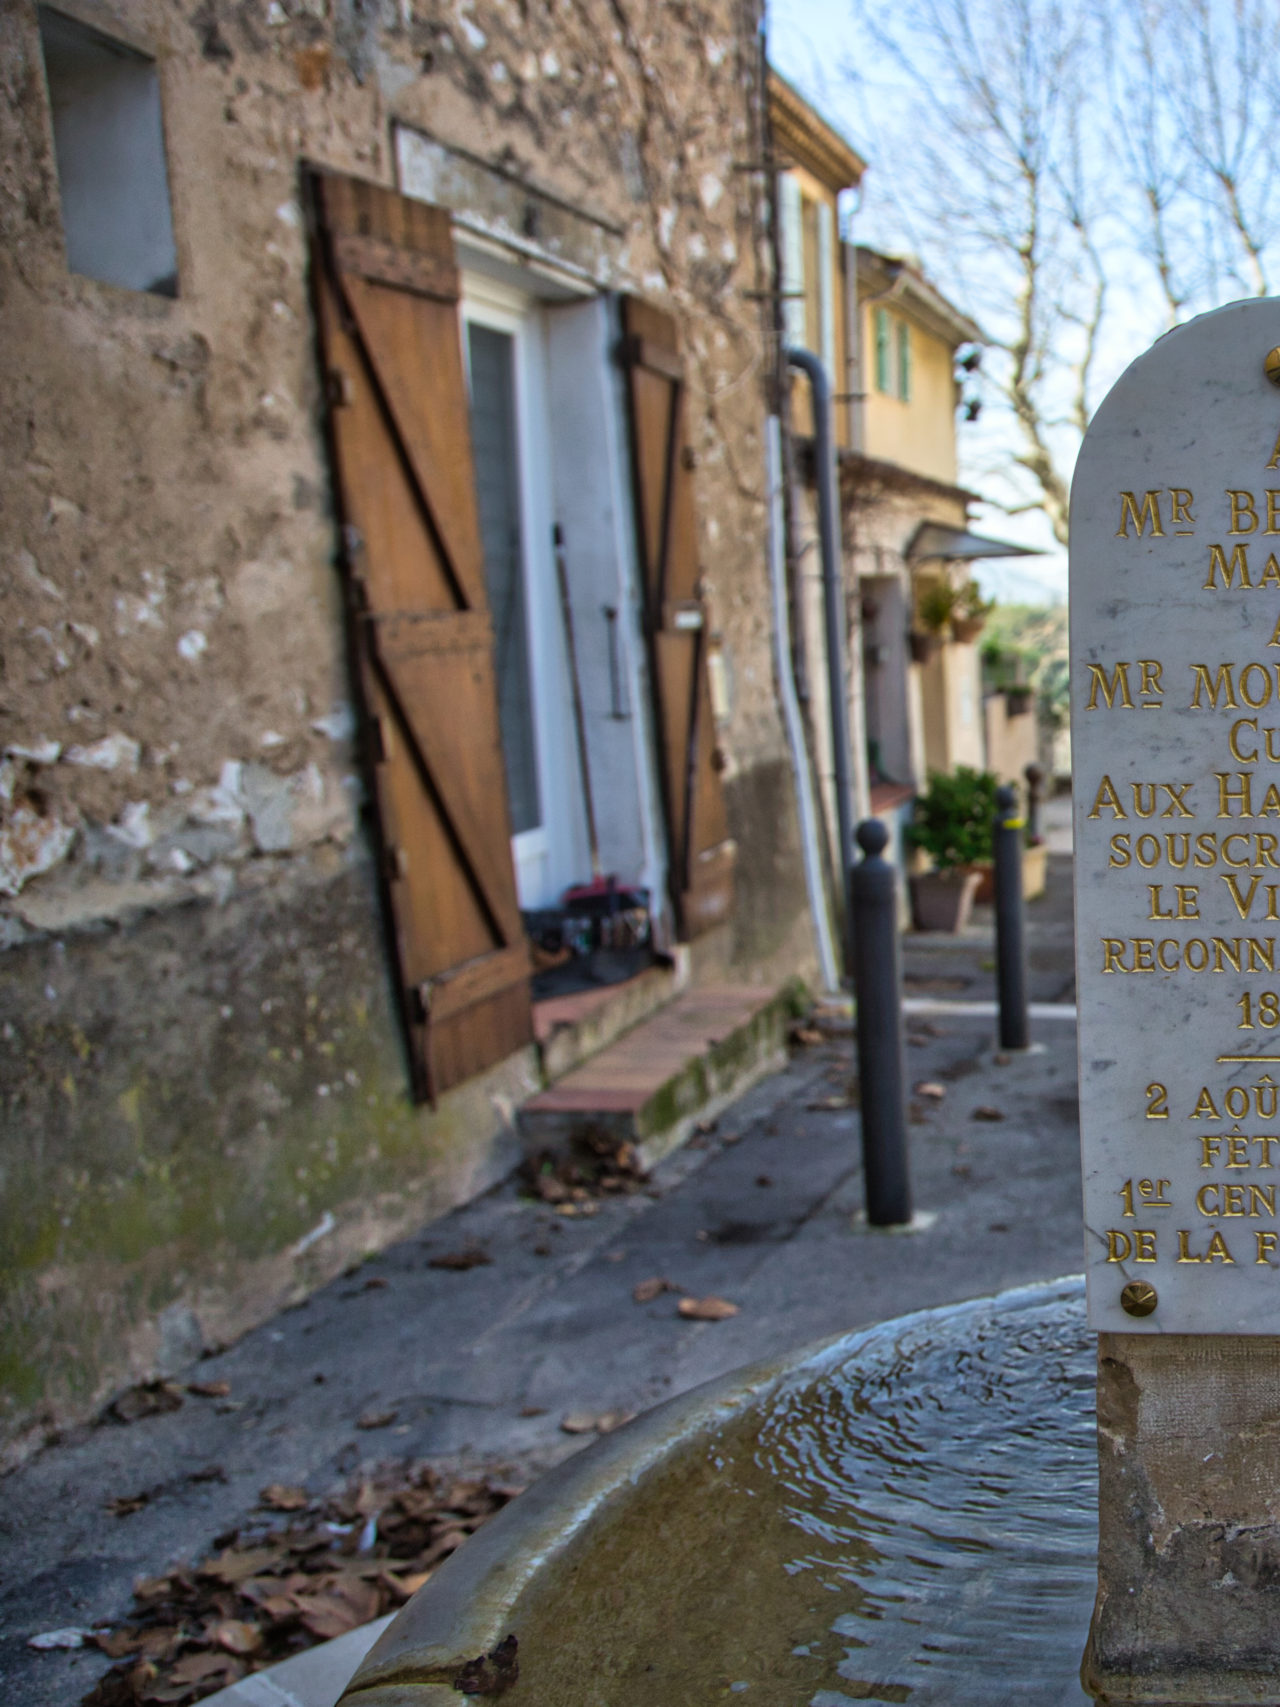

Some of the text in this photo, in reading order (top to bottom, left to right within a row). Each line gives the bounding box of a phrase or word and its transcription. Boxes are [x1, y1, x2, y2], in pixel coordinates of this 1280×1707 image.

[1087, 775, 1196, 819] AUX
[1147, 884, 1200, 920] LE
[1145, 1083, 1169, 1119] 2
[1106, 1230, 1157, 1263] DE
[1177, 1230, 1234, 1264] LA
